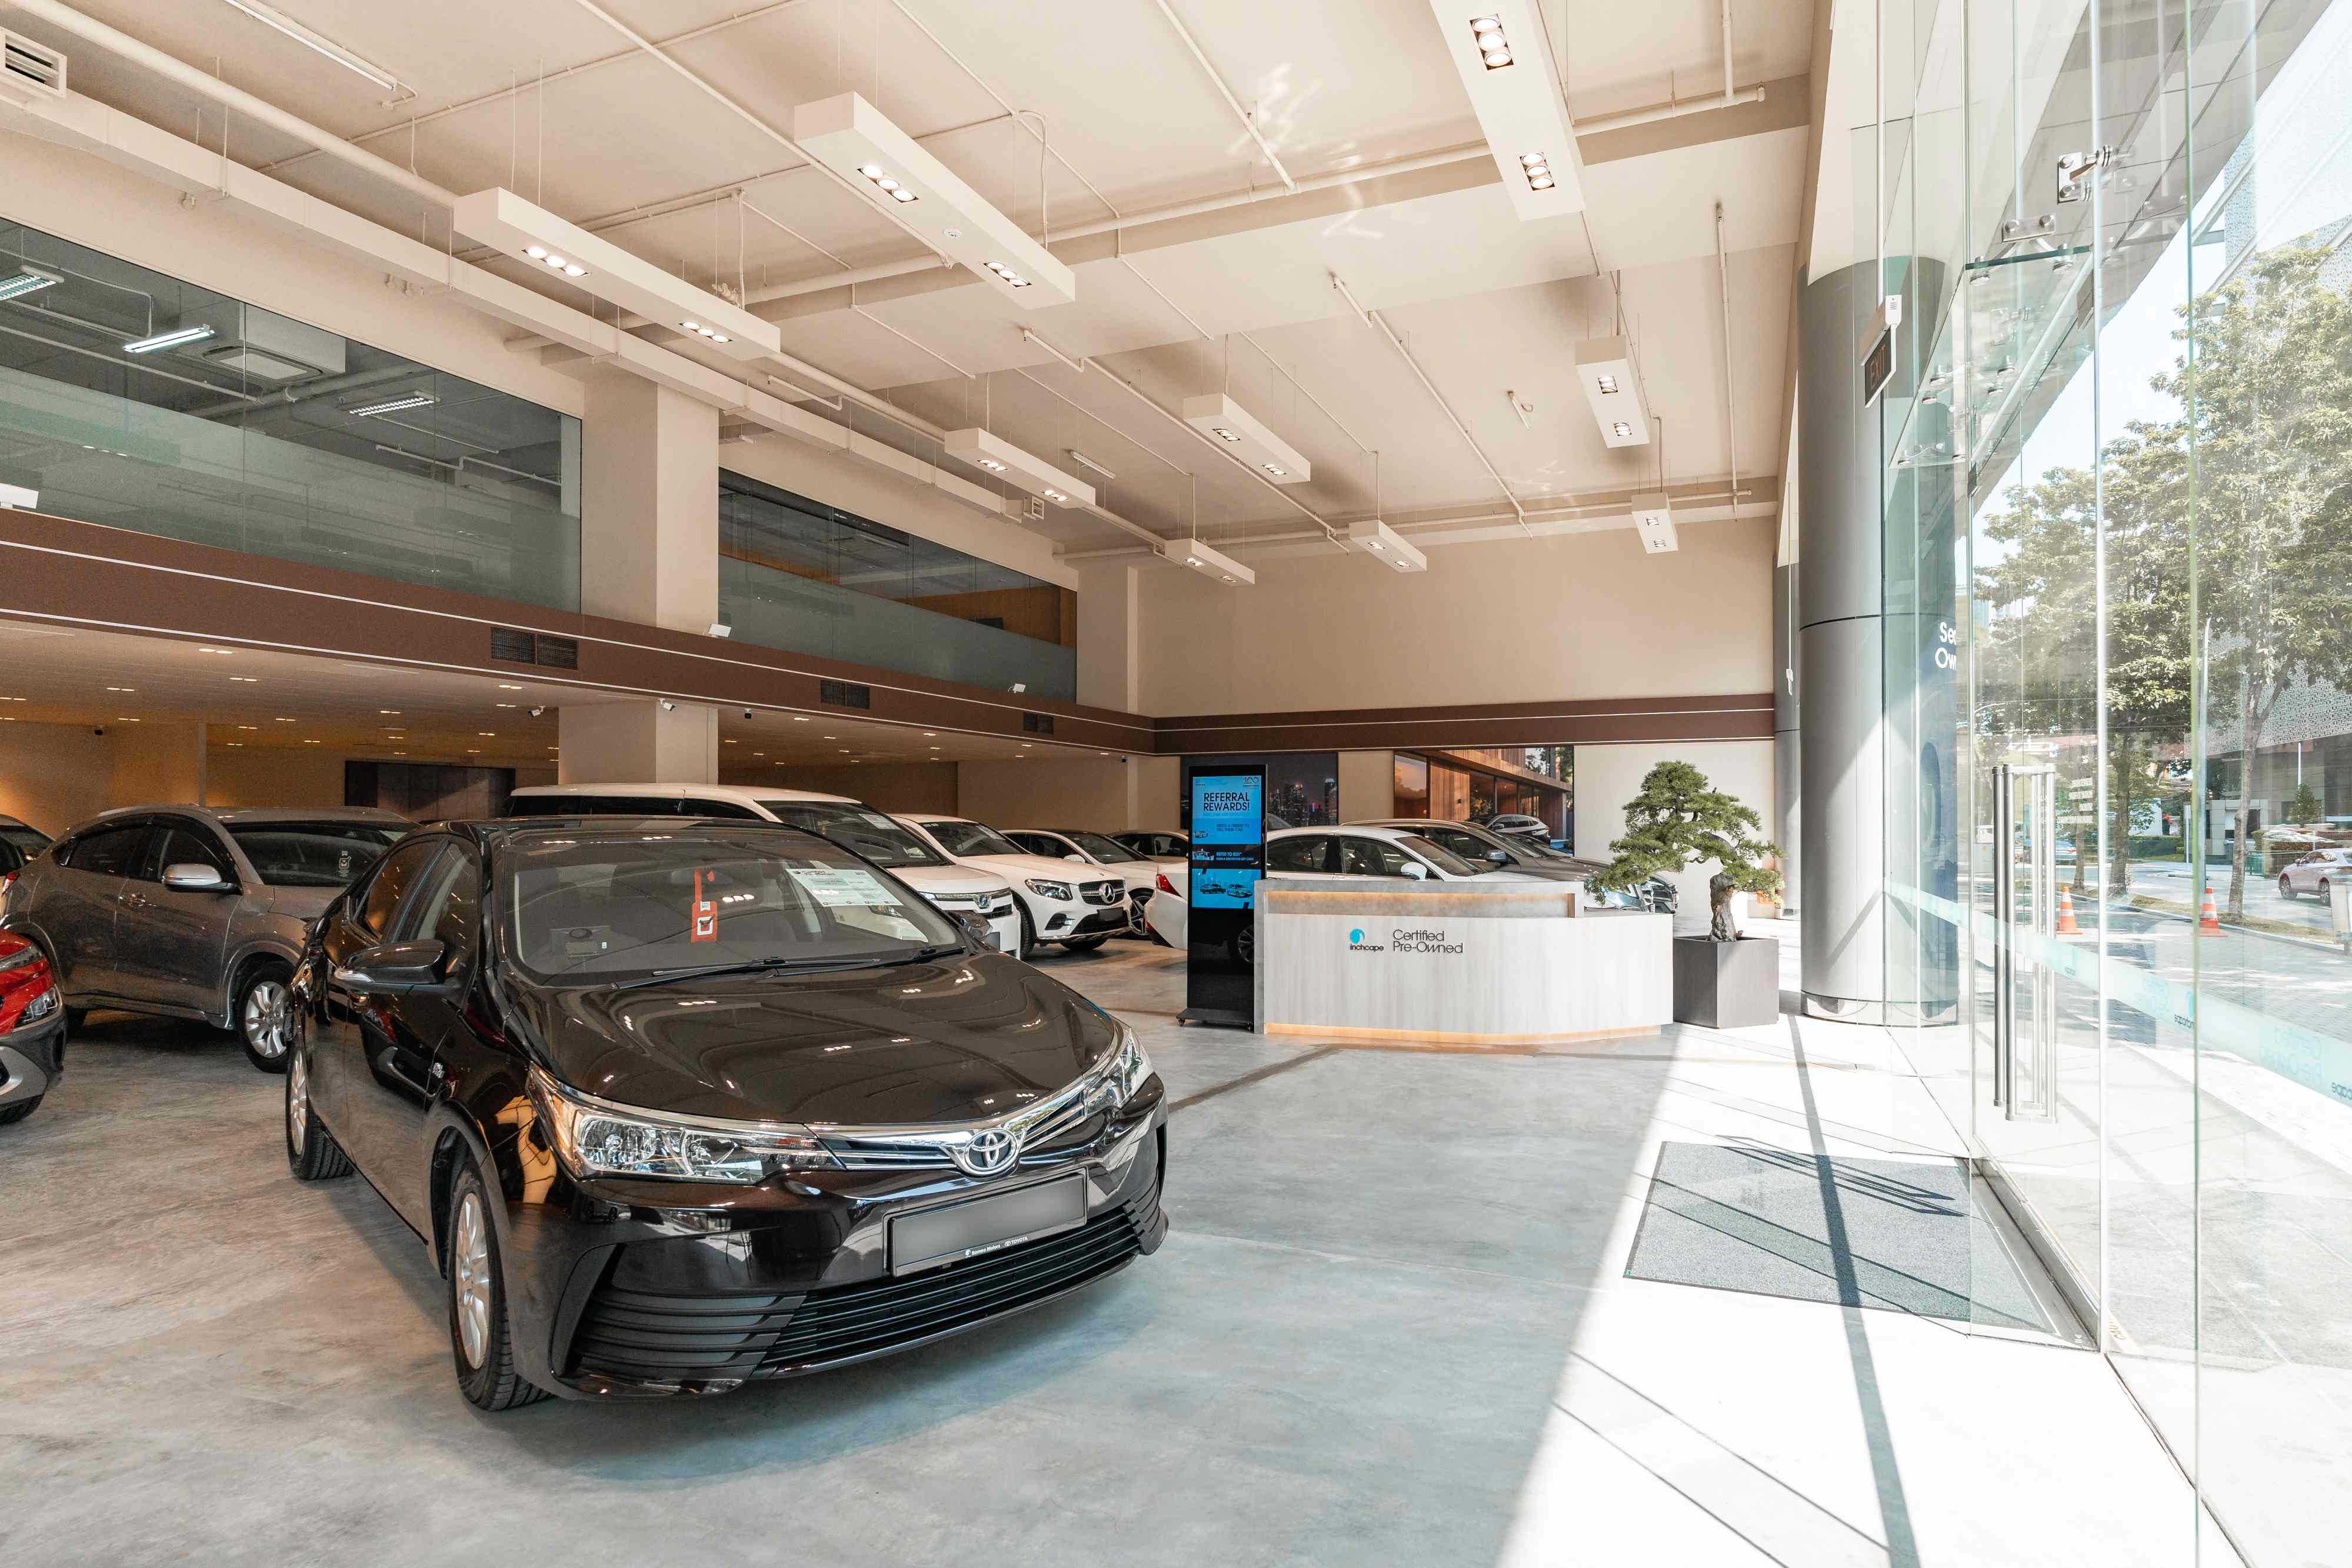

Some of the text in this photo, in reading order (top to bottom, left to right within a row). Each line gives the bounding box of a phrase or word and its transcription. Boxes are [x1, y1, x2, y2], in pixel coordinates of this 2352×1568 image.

[1870, 343, 1887, 391] EXIT
[1204, 792, 1250, 802] REFERRAL
[1204, 802, 1250, 812] REWARDS!
[1392, 929, 1445, 942] Certified
[1350, 943, 1384, 952] inchcape
[1392, 940, 1464, 954] Pre-Owned
[1011, 1236, 1028, 1245] TOYOTA
